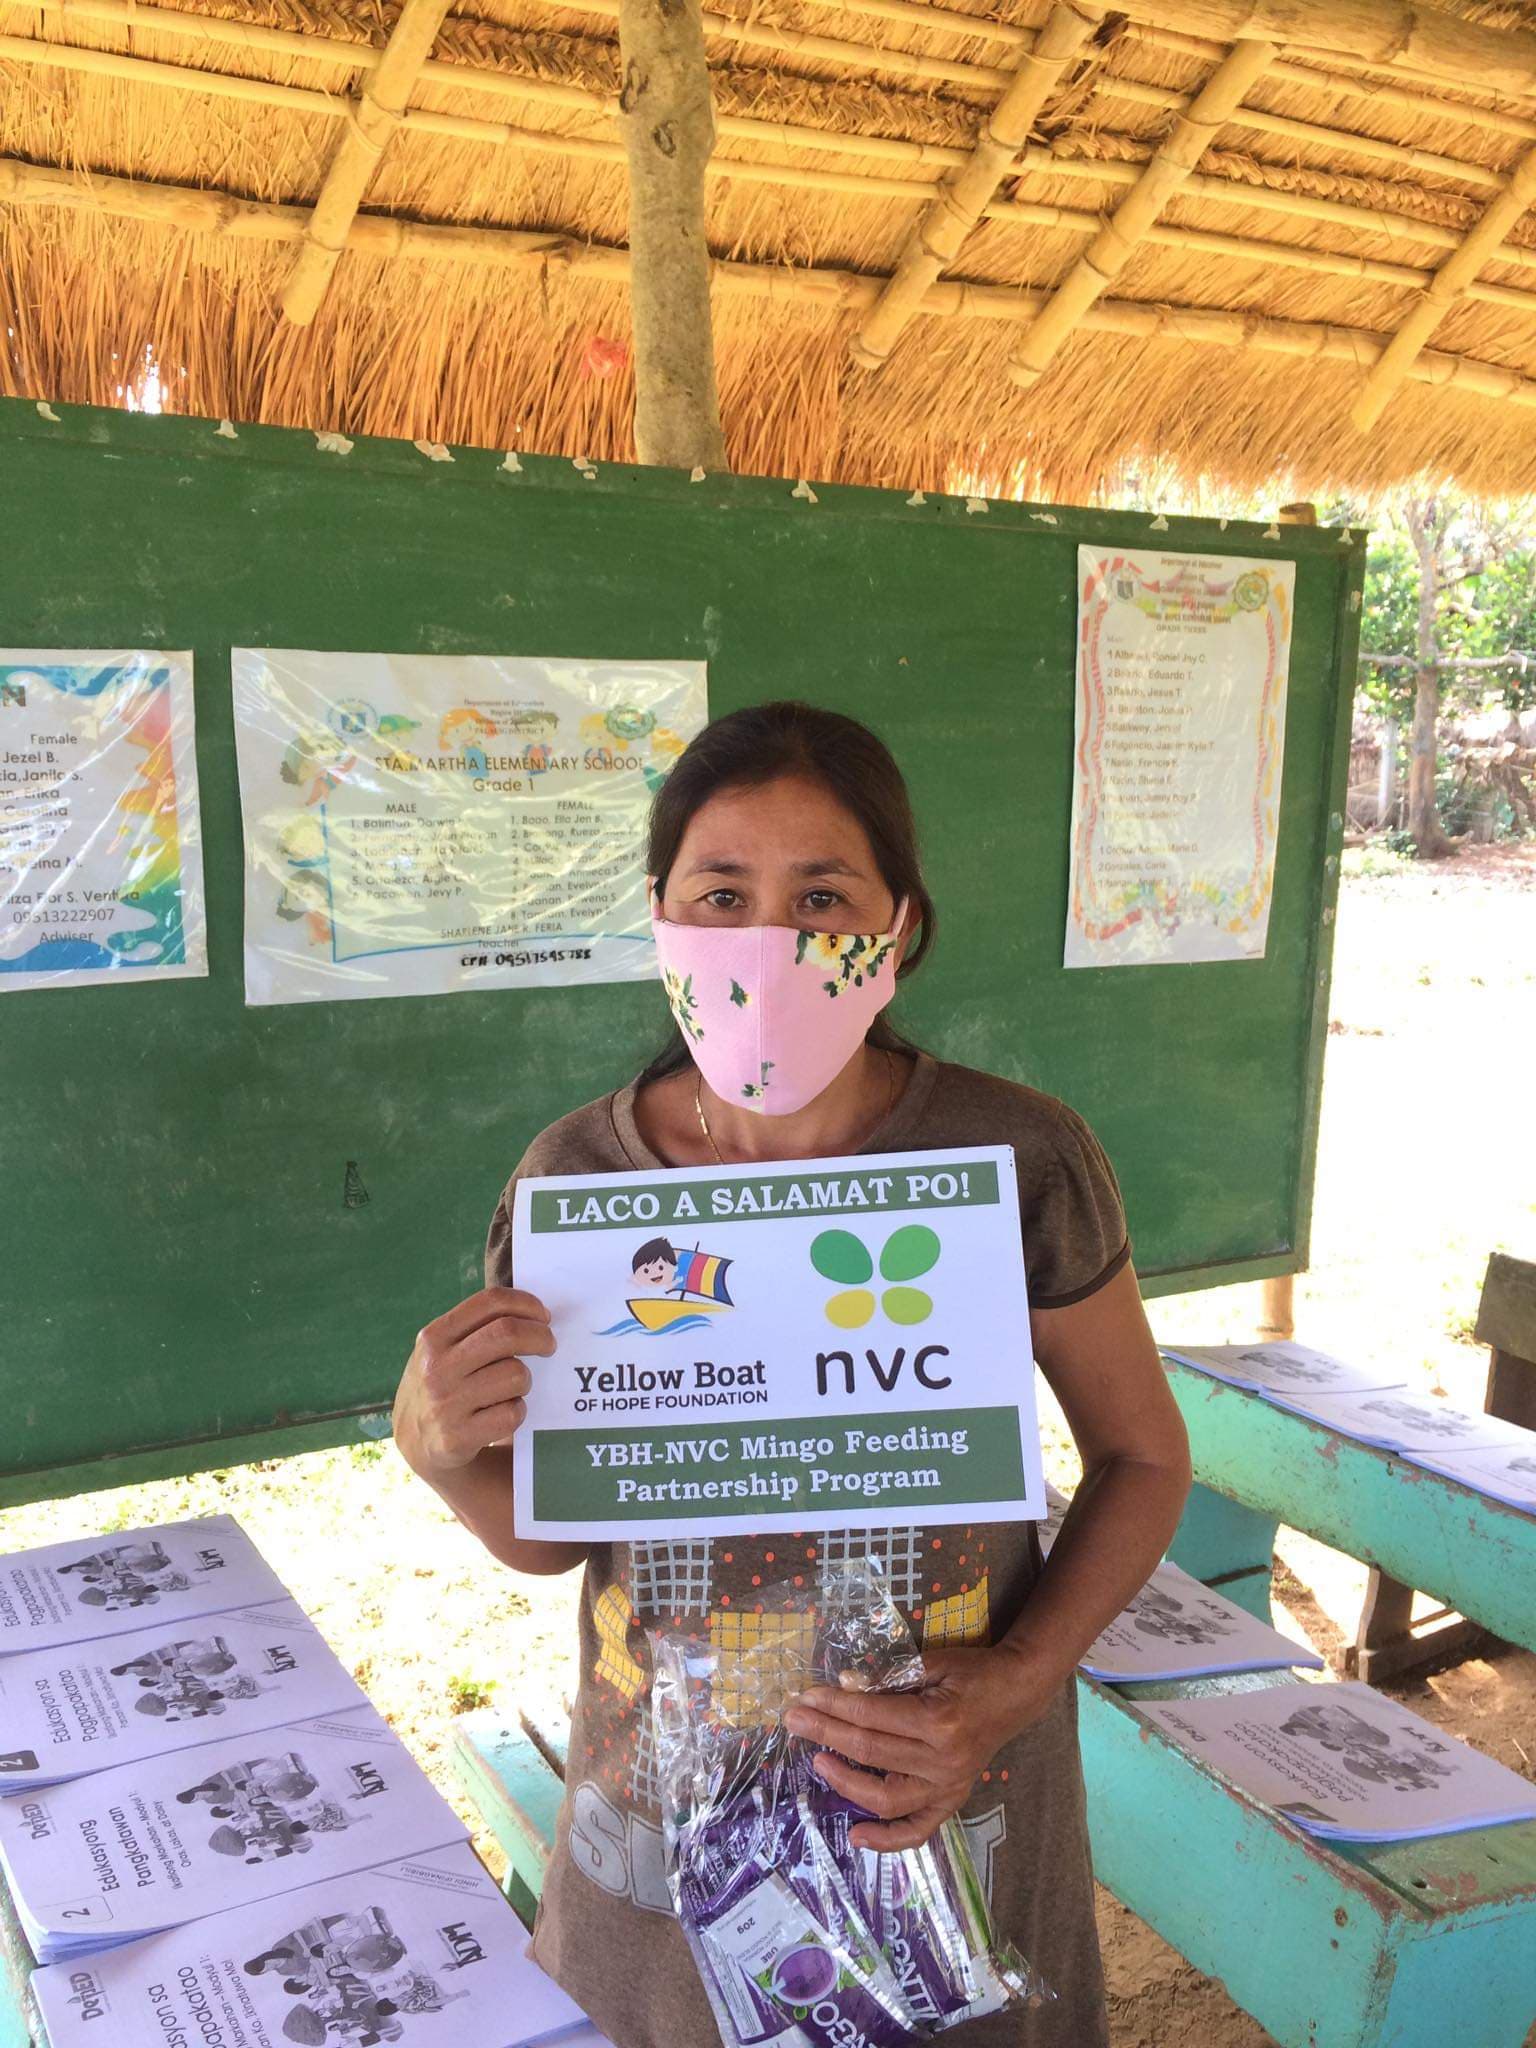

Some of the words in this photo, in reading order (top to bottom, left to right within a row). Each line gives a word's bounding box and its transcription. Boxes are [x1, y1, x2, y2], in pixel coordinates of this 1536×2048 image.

[30, 733, 78, 744] Female
[3, 752, 41, 764] Jezel
[46, 752, 59, 763] B.
[473, 777, 522, 792] Grade
[386, 803, 417, 813] MALE
[36, 891, 62, 903] For
[67, 891, 78, 903] S.
[83, 890, 139, 902] Venta
[40, 931, 94, 944] Adviser
[557, 1192, 661, 1226] LACO
[673, 1190, 700, 1218] A
[711, 1176, 893, 1217] SALAMAT
[906, 1171, 971, 1203] PO!
[574, 1362, 685, 1394] Yellow
[693, 1360, 767, 1388] Boat
[815, 1344, 953, 1397] nvc
[574, 1397, 598, 1412] OF
[602, 1394, 651, 1411] HOPE
[656, 1389, 769, 1409] FOUNDATION
[585, 1437, 730, 1468] YBH-NVC
[740, 1432, 835, 1466] Mingo
[844, 1426, 970, 1458] Feeding
[616, 1471, 800, 1504] Partnership
[810, 1464, 942, 1496] Program
[35, 1679, 51, 1691] sa
[40, 1691, 72, 1744] Edukasyon
[58, 1669, 100, 1742] Pagpapakatao
[350, 1761, 389, 1798] ADM
[79, 1818, 121, 1892] Edukasyong
[108, 1806, 156, 1888] Pangkatawan
[61, 1907, 91, 1919] 2
[736, 1916, 756, 1935] 20g
[442, 1921, 489, 1969] ADM
[760, 1946, 779, 1964] UBE
[68, 1972, 107, 2022] DepED
[147, 1983, 168, 2004] sa
